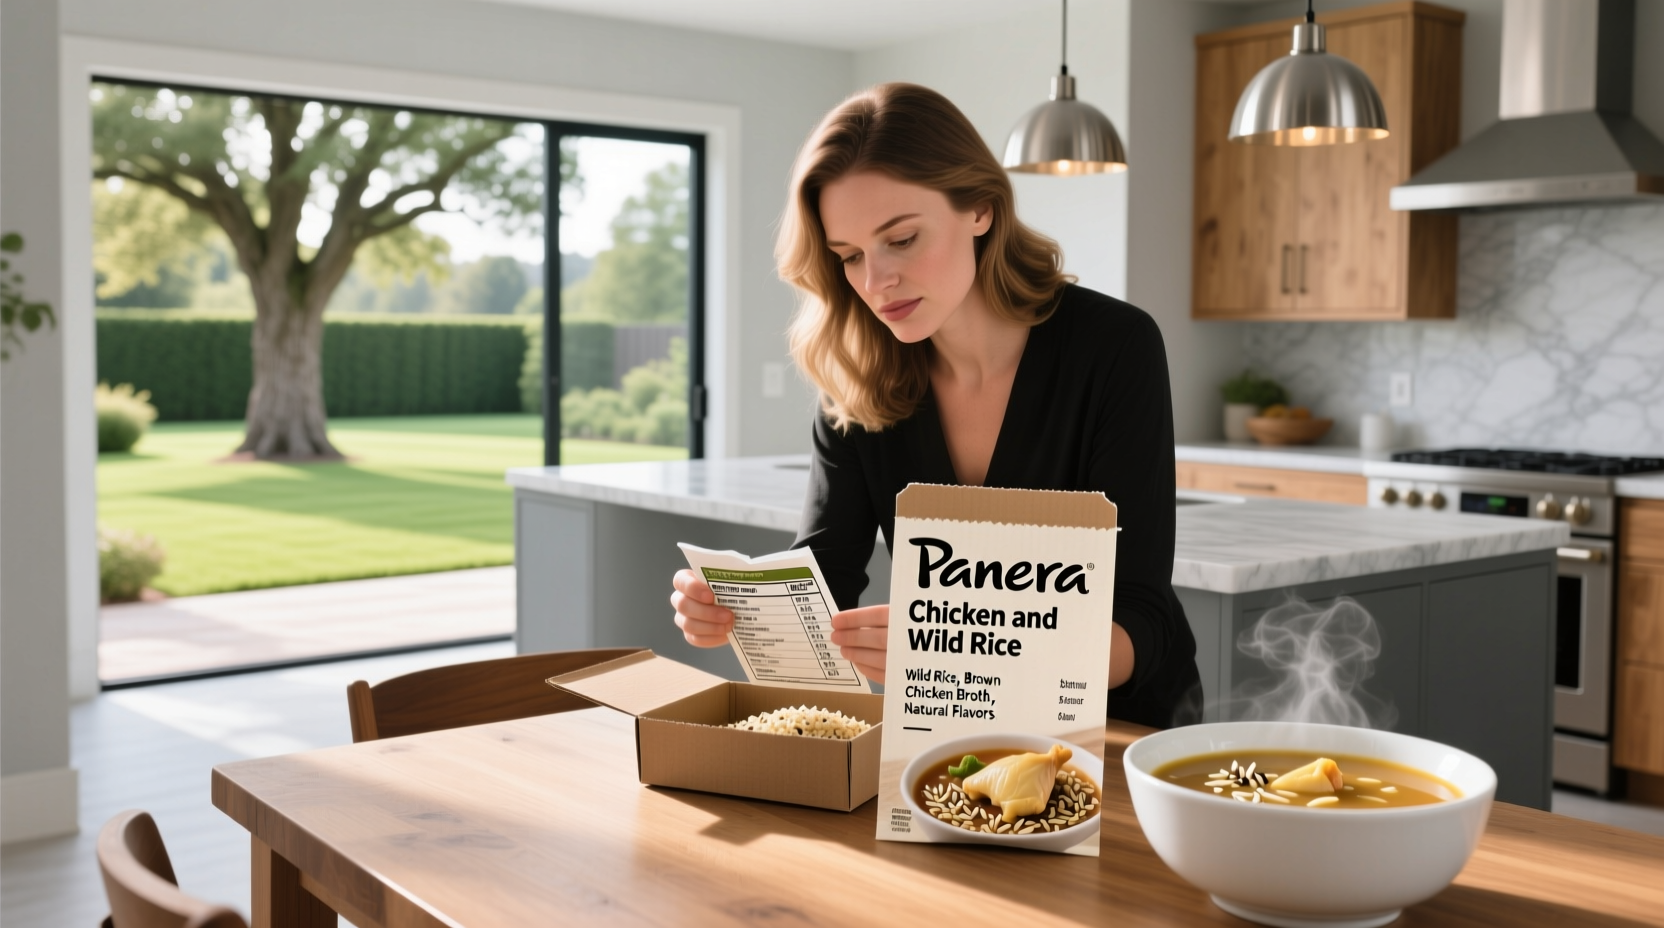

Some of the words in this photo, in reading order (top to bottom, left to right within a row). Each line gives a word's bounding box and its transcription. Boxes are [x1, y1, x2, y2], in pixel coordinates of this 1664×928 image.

[908, 537, 1090, 594] Panera
[908, 600, 1006, 627] Chicken
[1011, 606, 1058, 630] and
[907, 628, 964, 654] Wild
[970, 632, 1022, 657] Rice
[905, 668, 931, 682] Wild
[933, 669, 961, 687] Rice,
[905, 685, 953, 701] Chicken
[956, 688, 996, 706] Broth,
[904, 702, 948, 717] Natural
[952, 704, 996, 720] Flavors
